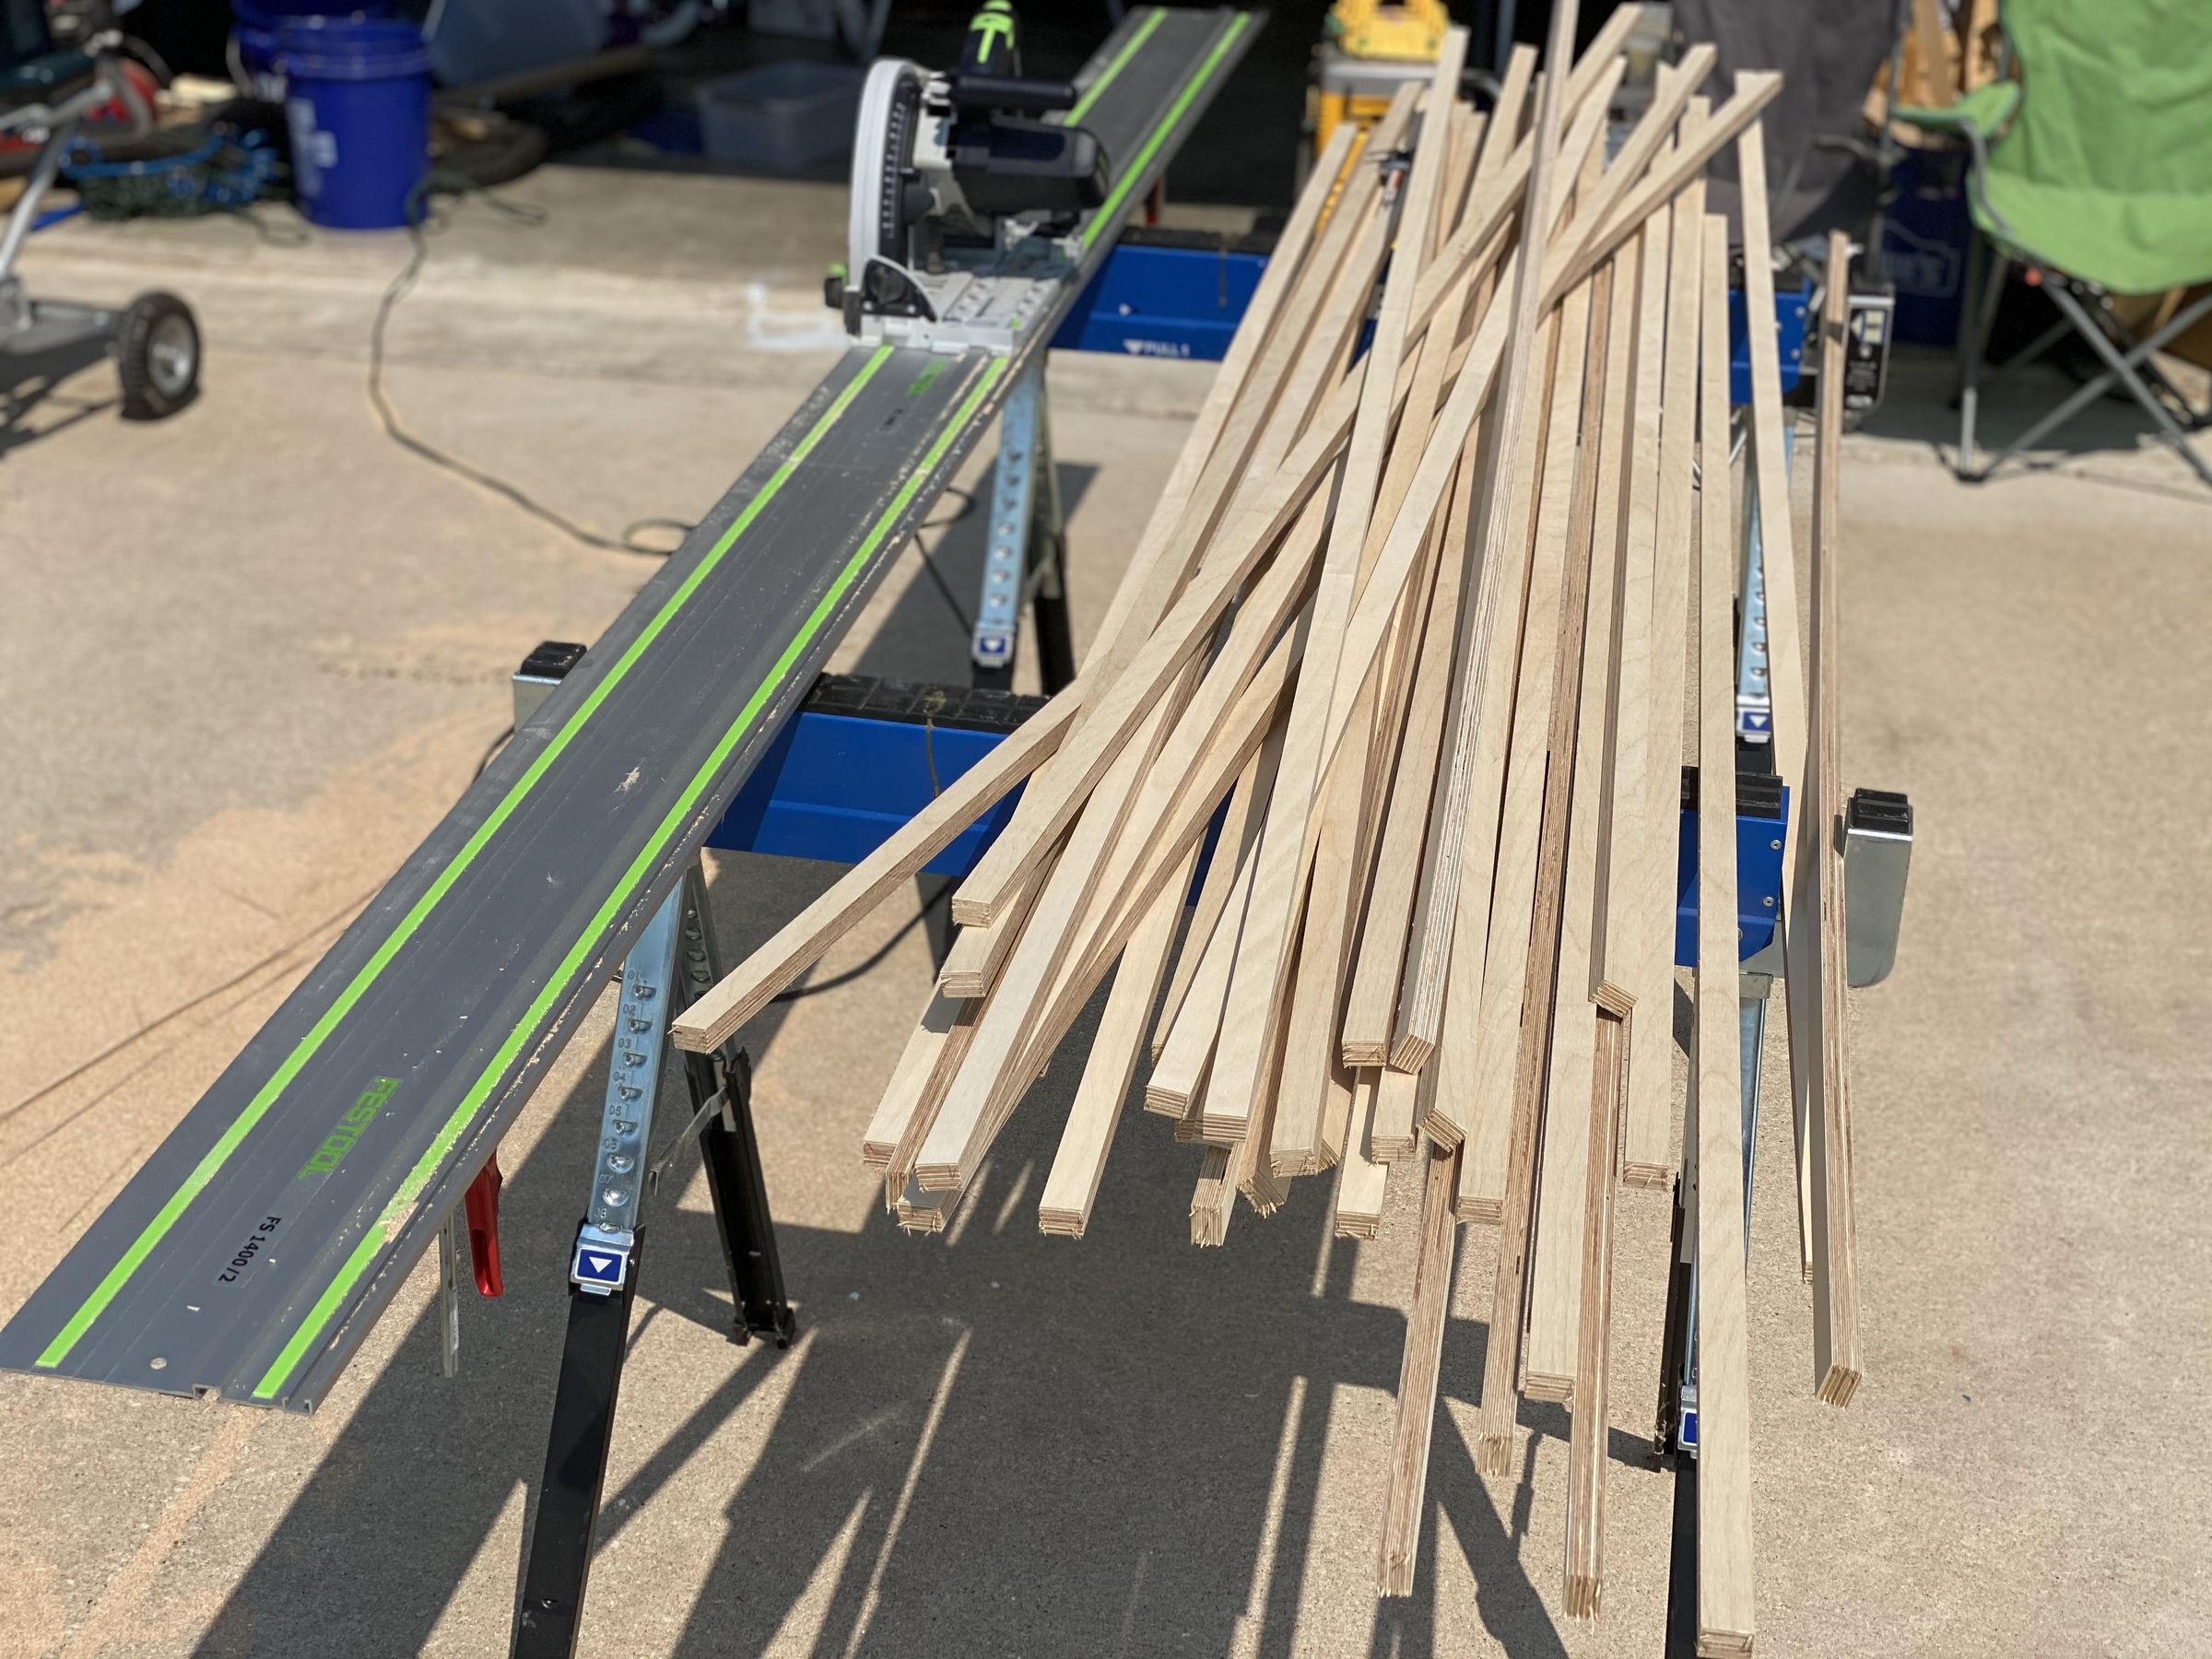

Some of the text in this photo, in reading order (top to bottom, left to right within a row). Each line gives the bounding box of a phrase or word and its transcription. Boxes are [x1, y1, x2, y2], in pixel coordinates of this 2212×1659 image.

[618, 1038, 631, 1049] 03
[613, 1071, 626, 1083] 04
[296, 1076, 399, 1181] FESTOOL
[599, 1173, 614, 1184] 07
[218, 1216, 282, 1282] FS 1400/2
